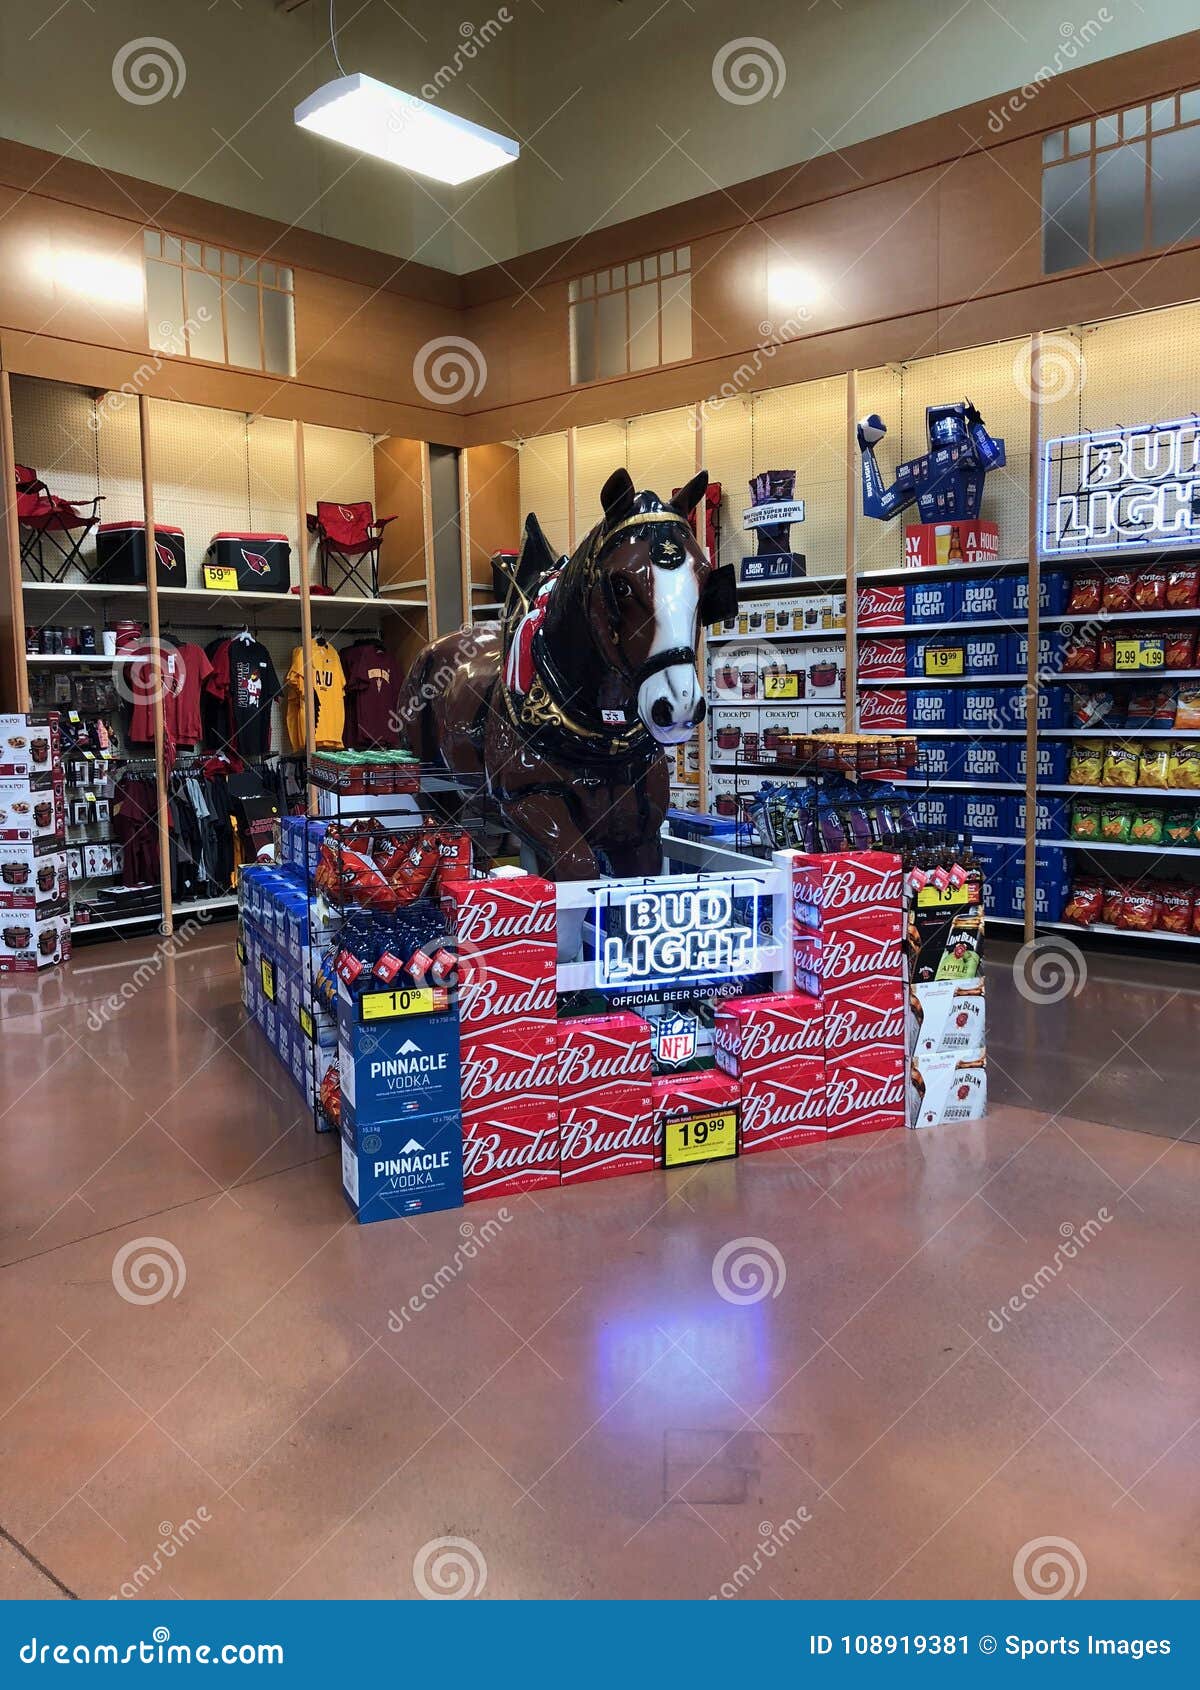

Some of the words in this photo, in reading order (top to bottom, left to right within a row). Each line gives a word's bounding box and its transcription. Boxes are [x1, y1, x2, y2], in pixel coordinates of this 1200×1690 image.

[966, 532, 977, 548] A
[966, 588, 994, 600] BUD
[1016, 584, 1046, 596] BD
[916, 592, 942, 604] BUD
[912, 603, 945, 616] LIGHT
[962, 599, 997, 613] LIGHT
[967, 643, 995, 654] BUD
[1020, 640, 1050, 652] BD
[1016, 651, 1053, 664] LIHT
[1117, 650, 1136, 664] 2.99
[1145, 651, 1162, 664] 1.99
[917, 698, 943, 709] BUD
[967, 697, 994, 708] BUD
[1017, 696, 1048, 708] BD
[913, 708, 945, 721] LIGHT
[963, 707, 997, 721] LIGHT
[968, 750, 996, 762] BUD
[1020, 750, 1050, 763] BD
[964, 761, 1000, 774] LIGHT
[1017, 762, 1053, 774] LIHT
[967, 804, 995, 815] BUD
[1019, 805, 1049, 817] BD
[963, 815, 999, 827] LIGHT
[1015, 886, 1045, 899] BD
[1124, 896, 1153, 906] Doritos
[625, 890, 733, 936] BUD
[961, 931, 977, 950] BEAM
[604, 928, 752, 979] LIGHT
[942, 964, 968, 973] APPLE
[612, 993, 660, 1007] OFFICIAL
[663, 990, 690, 1001] BEER
[692, 985, 743, 999] SPONSOR
[949, 1004, 962, 1016] JIM
[963, 1001, 980, 1016] BEAM
[661, 1035, 692, 1061] NFL
[371, 1053, 447, 1078] PINNACLE
[387, 1075, 431, 1090] VODKA
[950, 1077, 964, 1090] JIM
[964, 1073, 981, 1088] BEAM
[374, 1151, 449, 1178] PINNACLE
[390, 1172, 433, 1189] VODKA
